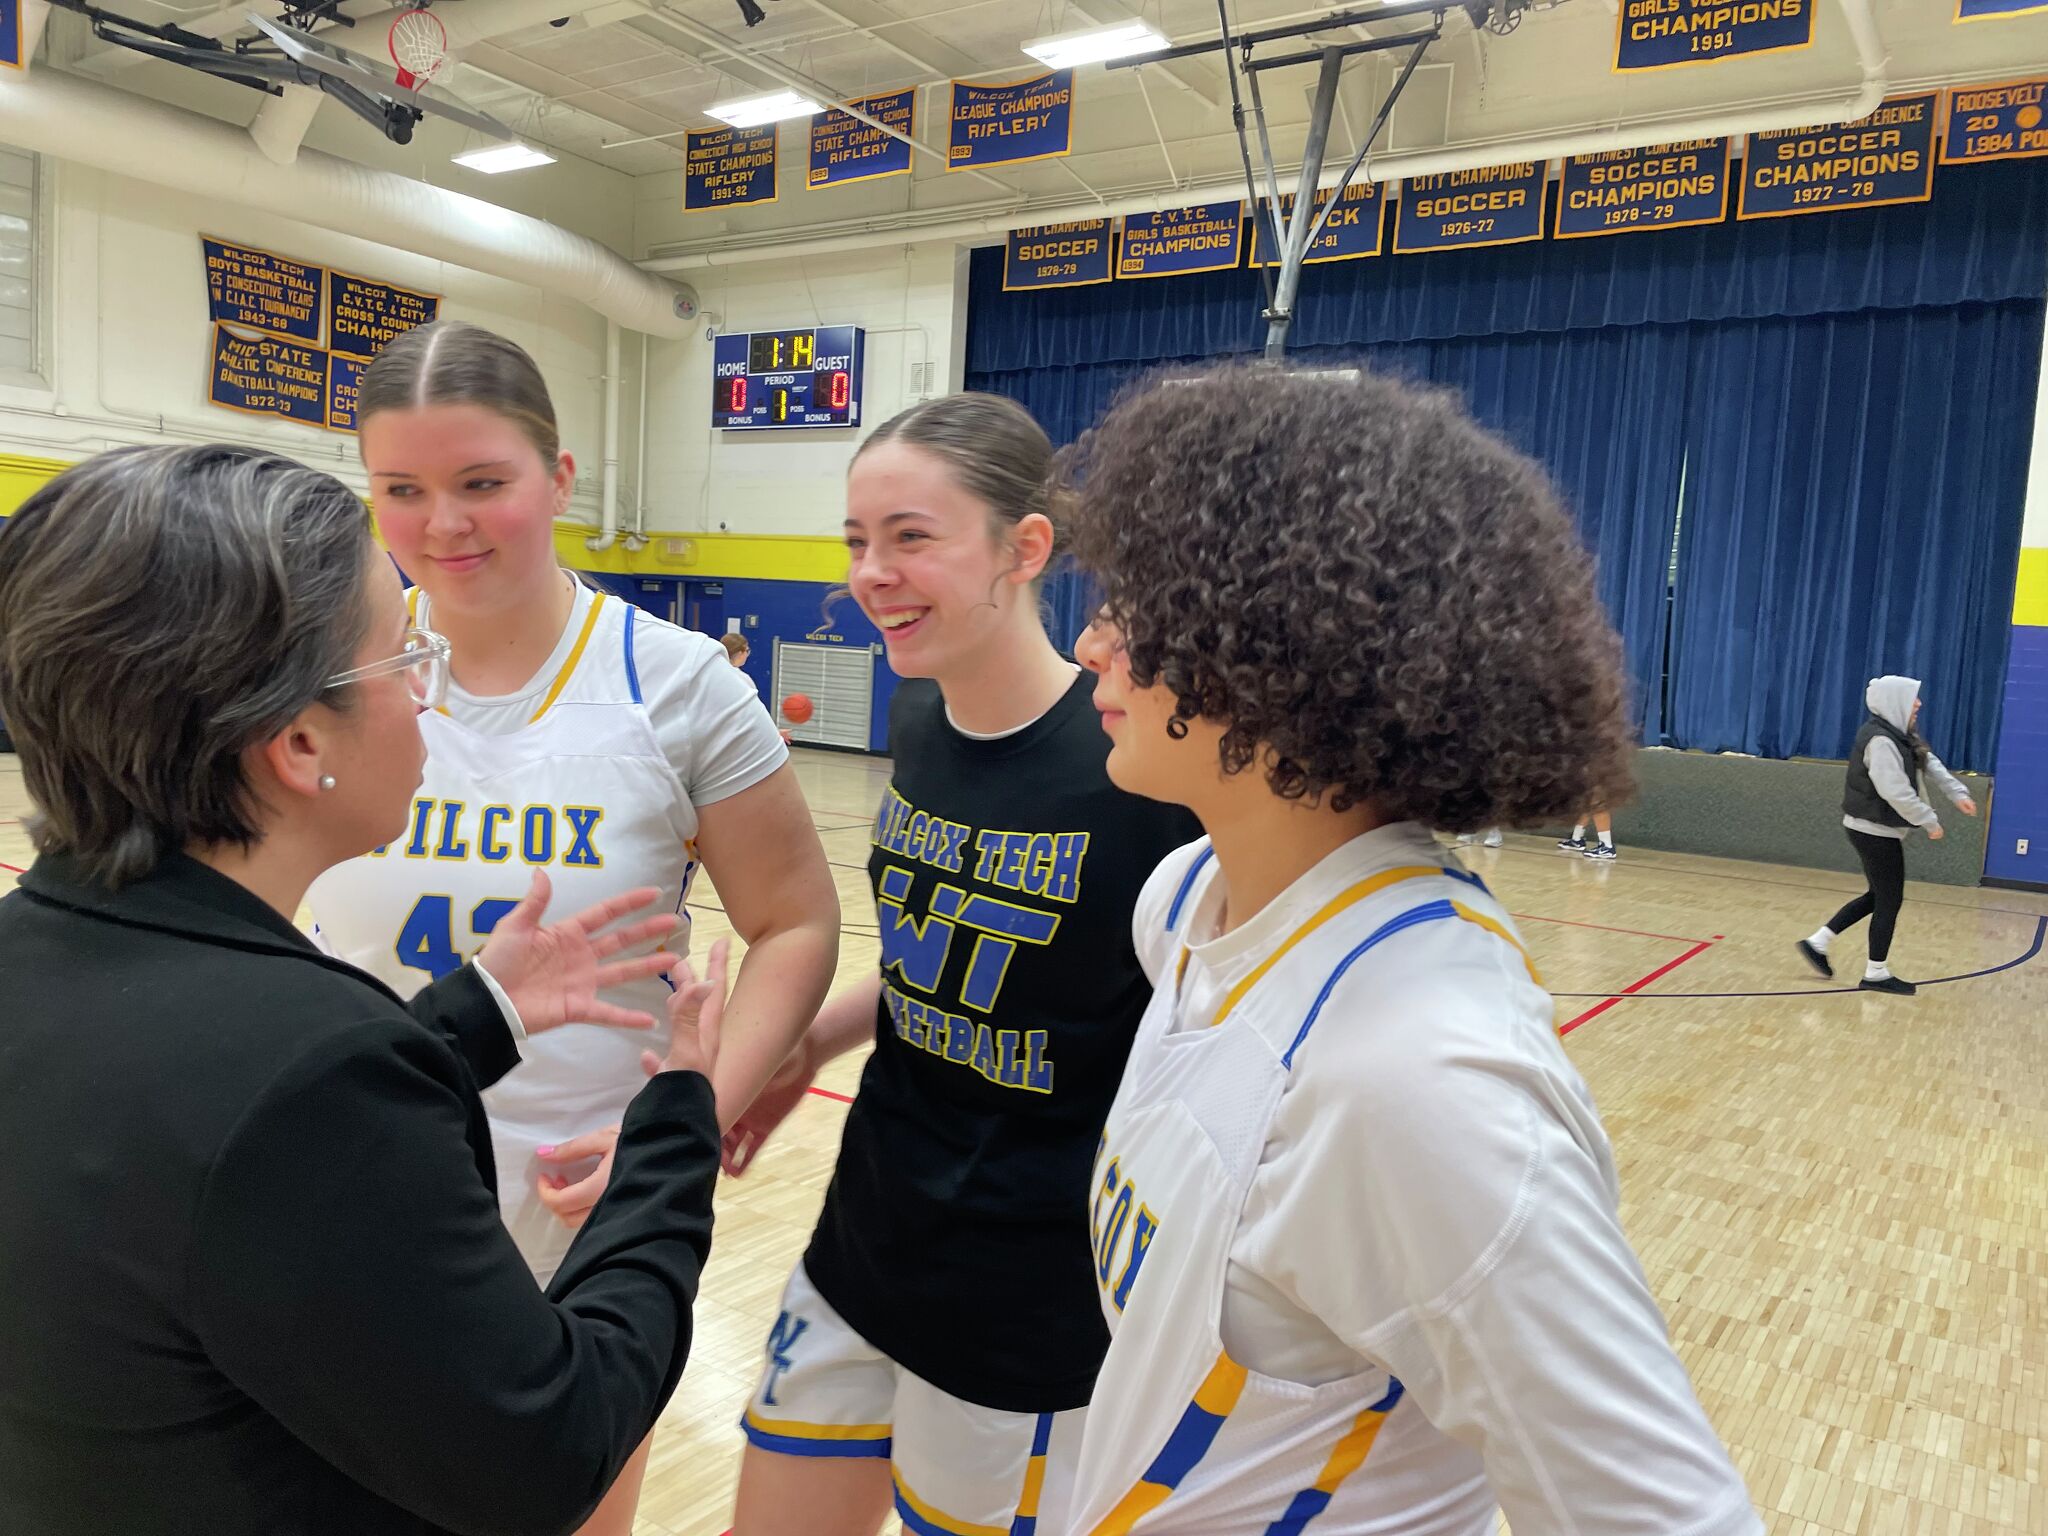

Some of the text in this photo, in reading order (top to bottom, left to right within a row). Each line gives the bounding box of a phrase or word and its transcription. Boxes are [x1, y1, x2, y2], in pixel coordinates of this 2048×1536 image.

[1628, 0, 1680, 18] GIRLS
[1631, 0, 1803, 41] CHAMPIONS
[1690, 31, 1733, 52] 1991
[954, 89, 1069, 120] LEAGUE CHAMPIONS
[968, 90, 1016, 100] WILCOX
[1956, 85, 2046, 113] ROOSEVELT
[826, 106, 866, 121] WILCX
[870, 98, 899, 111] TECH
[883, 107, 911, 123] SCHOOL
[968, 112, 1051, 139] RIFLERY
[1966, 115, 1999, 132] 20
[700, 128, 764, 145] WILCOX TECH
[815, 135, 844, 152] STATE
[1777, 129, 1901, 161] SOCCER
[687, 150, 773, 176] STATE CHAMPIONS
[829, 141, 889, 164] RIFLERY
[951, 147, 971, 157] 1993
[704, 170, 755, 188] RIFLERY
[1413, 161, 1535, 192] CITY CHAMPIONS
[1589, 155, 1698, 185] SOCCER
[1754, 150, 1920, 188] CHAMPIONS
[711, 185, 748, 200] 1991-92
[1416, 188, 1527, 218] SOCCER
[1569, 174, 1715, 209] CHAMPIONS
[1127, 218, 1236, 241] GIRLS BASKETBALL
[1441, 218, 1495, 237] 1976-77
[1018, 238, 1098, 261] SOCCER
[1129, 233, 1231, 257] CHAMPIONS
[223, 248, 305, 276] WILCOX TECH
[1037, 263, 1077, 278] 1978-79
[208, 256, 317, 293] BOYS BASKETBALL
[210, 271, 314, 307] 25 CONSECUTIVE YEARS
[346, 282, 424, 309] WILCOX TECH
[212, 287, 221, 301] IN
[259, 297, 311, 322] TOURNAMENT
[336, 304, 375, 323] CROSS
[400, 307, 426, 322] CITY
[238, 309, 288, 329] 1943-68
[228, 340, 312, 366] MID STATE
[772, 335, 813, 368] 1:14
[815, 355, 849, 370] GUEST
[717, 362, 746, 376] HOME
[764, 375, 795, 385] PERIOD
[731, 377, 747, 411] 0
[832, 371, 848, 407] 0
[728, 416, 752, 424] BONUS
[805, 413, 831, 422] BONUS
[361, 797, 604, 869] ILCOX
[973, 829, 1091, 904] TECH
